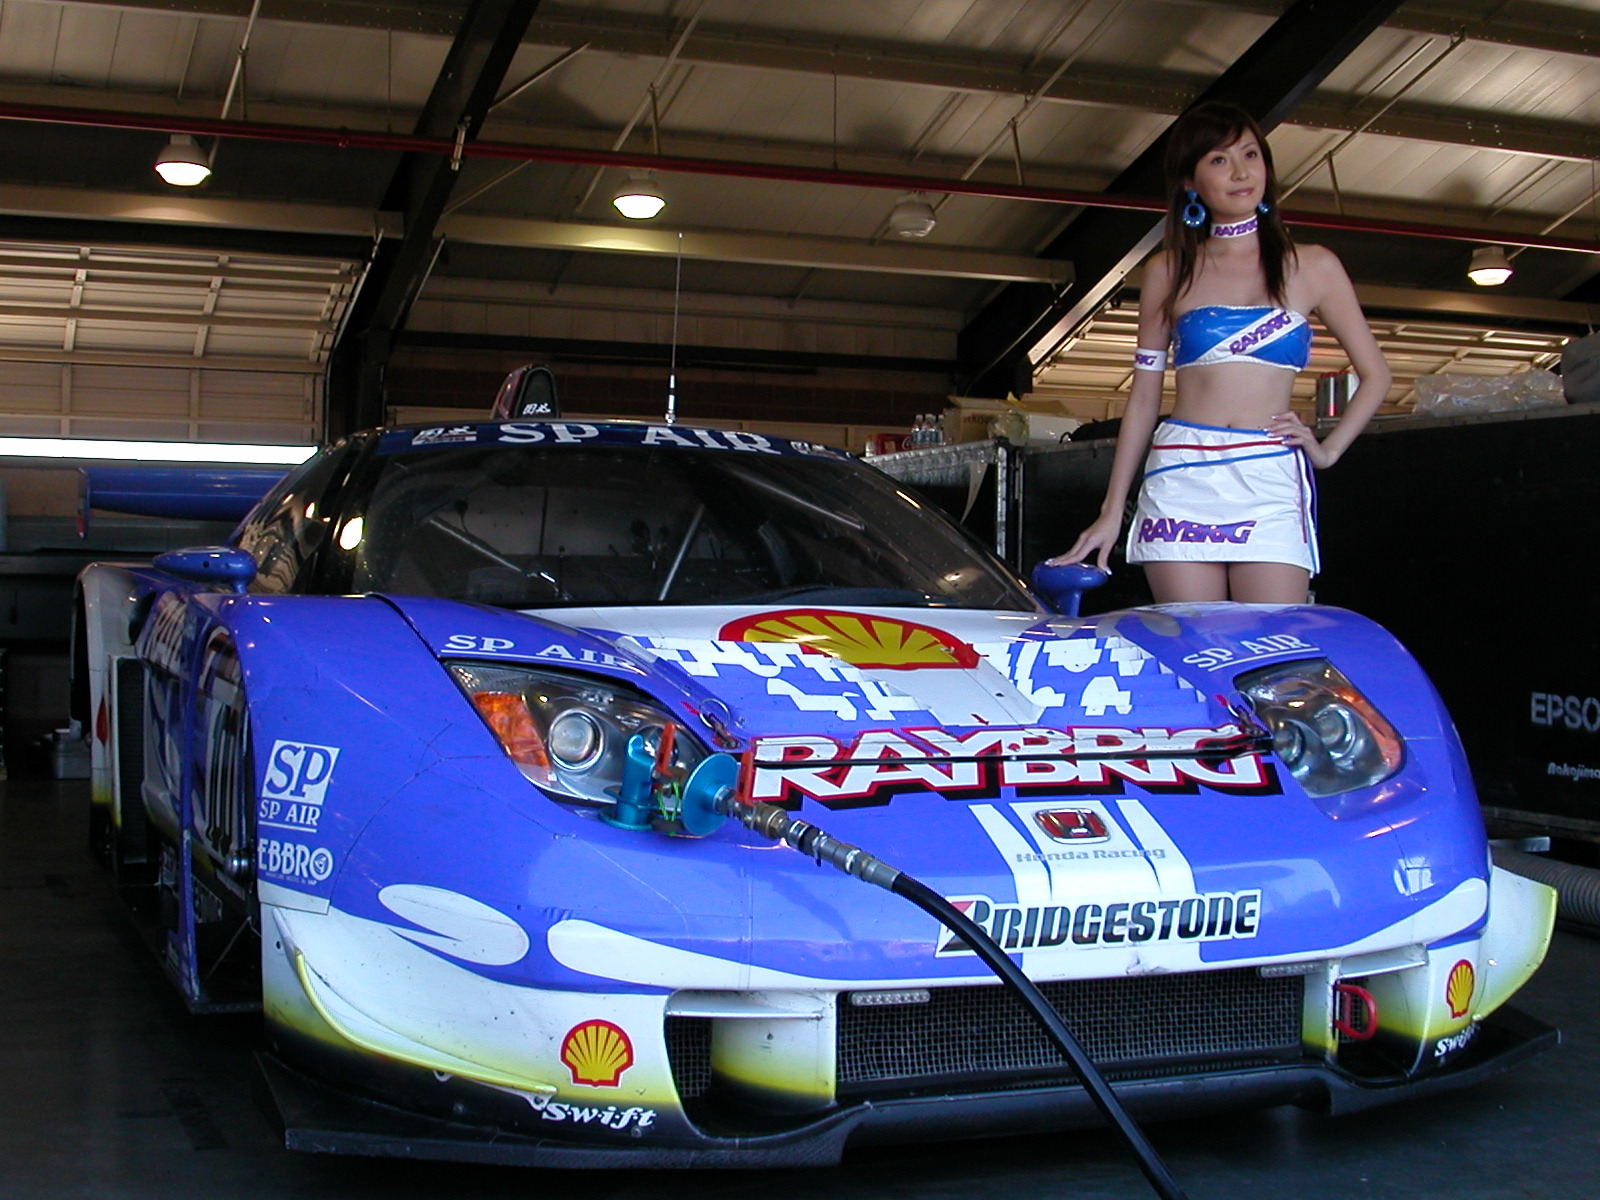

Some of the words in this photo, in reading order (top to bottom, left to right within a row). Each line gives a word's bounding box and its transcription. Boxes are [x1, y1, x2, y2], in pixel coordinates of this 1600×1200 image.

[1229, 311, 1292, 355] RAYBRIG
[498, 422, 600, 443] SP
[641, 426, 782, 455] AIR
[1138, 518, 1257, 544] RAYBRIG
[445, 635, 515, 652] SP
[1183, 647, 1233, 668] SP
[1240, 634, 1311, 654] AIR
[1531, 692, 1600, 732] EPSO
[265, 743, 332, 798] SP
[751, 725, 1272, 800] RAYBRIG
[259, 799, 281, 819] SP
[285, 804, 321, 826] AIR
[1017, 850, 1088, 863] Honda
[1093, 848, 1166, 860] Racing
